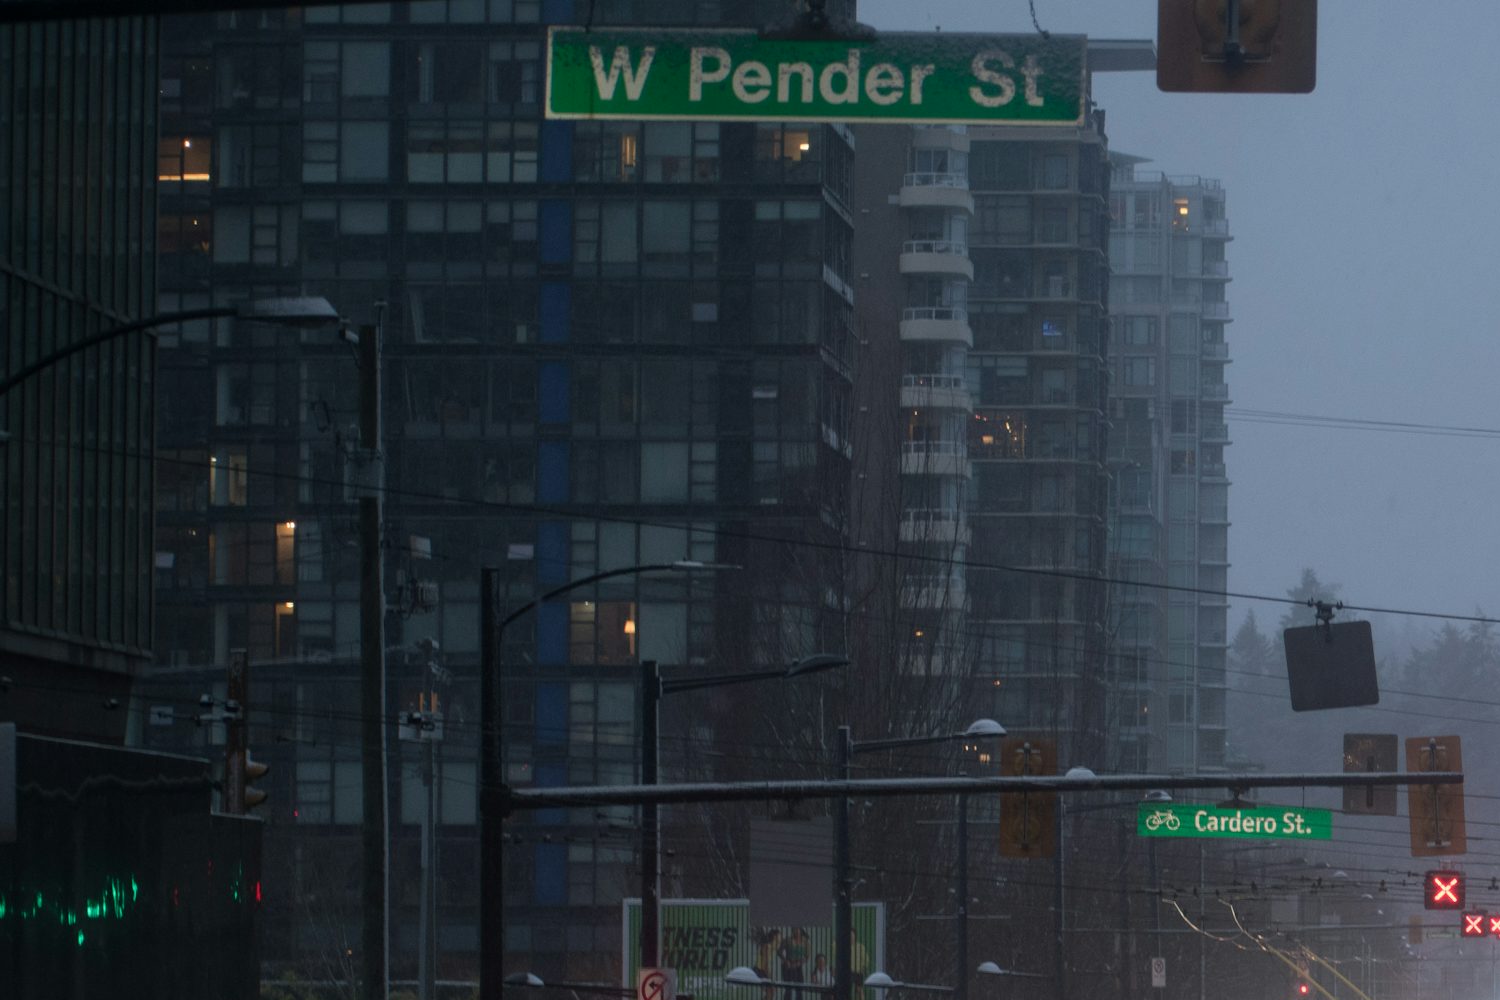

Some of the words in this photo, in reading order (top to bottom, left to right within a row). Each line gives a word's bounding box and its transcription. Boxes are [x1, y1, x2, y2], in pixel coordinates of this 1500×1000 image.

[588, 44, 655, 102] W
[688, 47, 935, 106] Pender
[968, 49, 1045, 109] St
[1194, 809, 1277, 834] Cardero
[1282, 811, 1313, 835] St.
